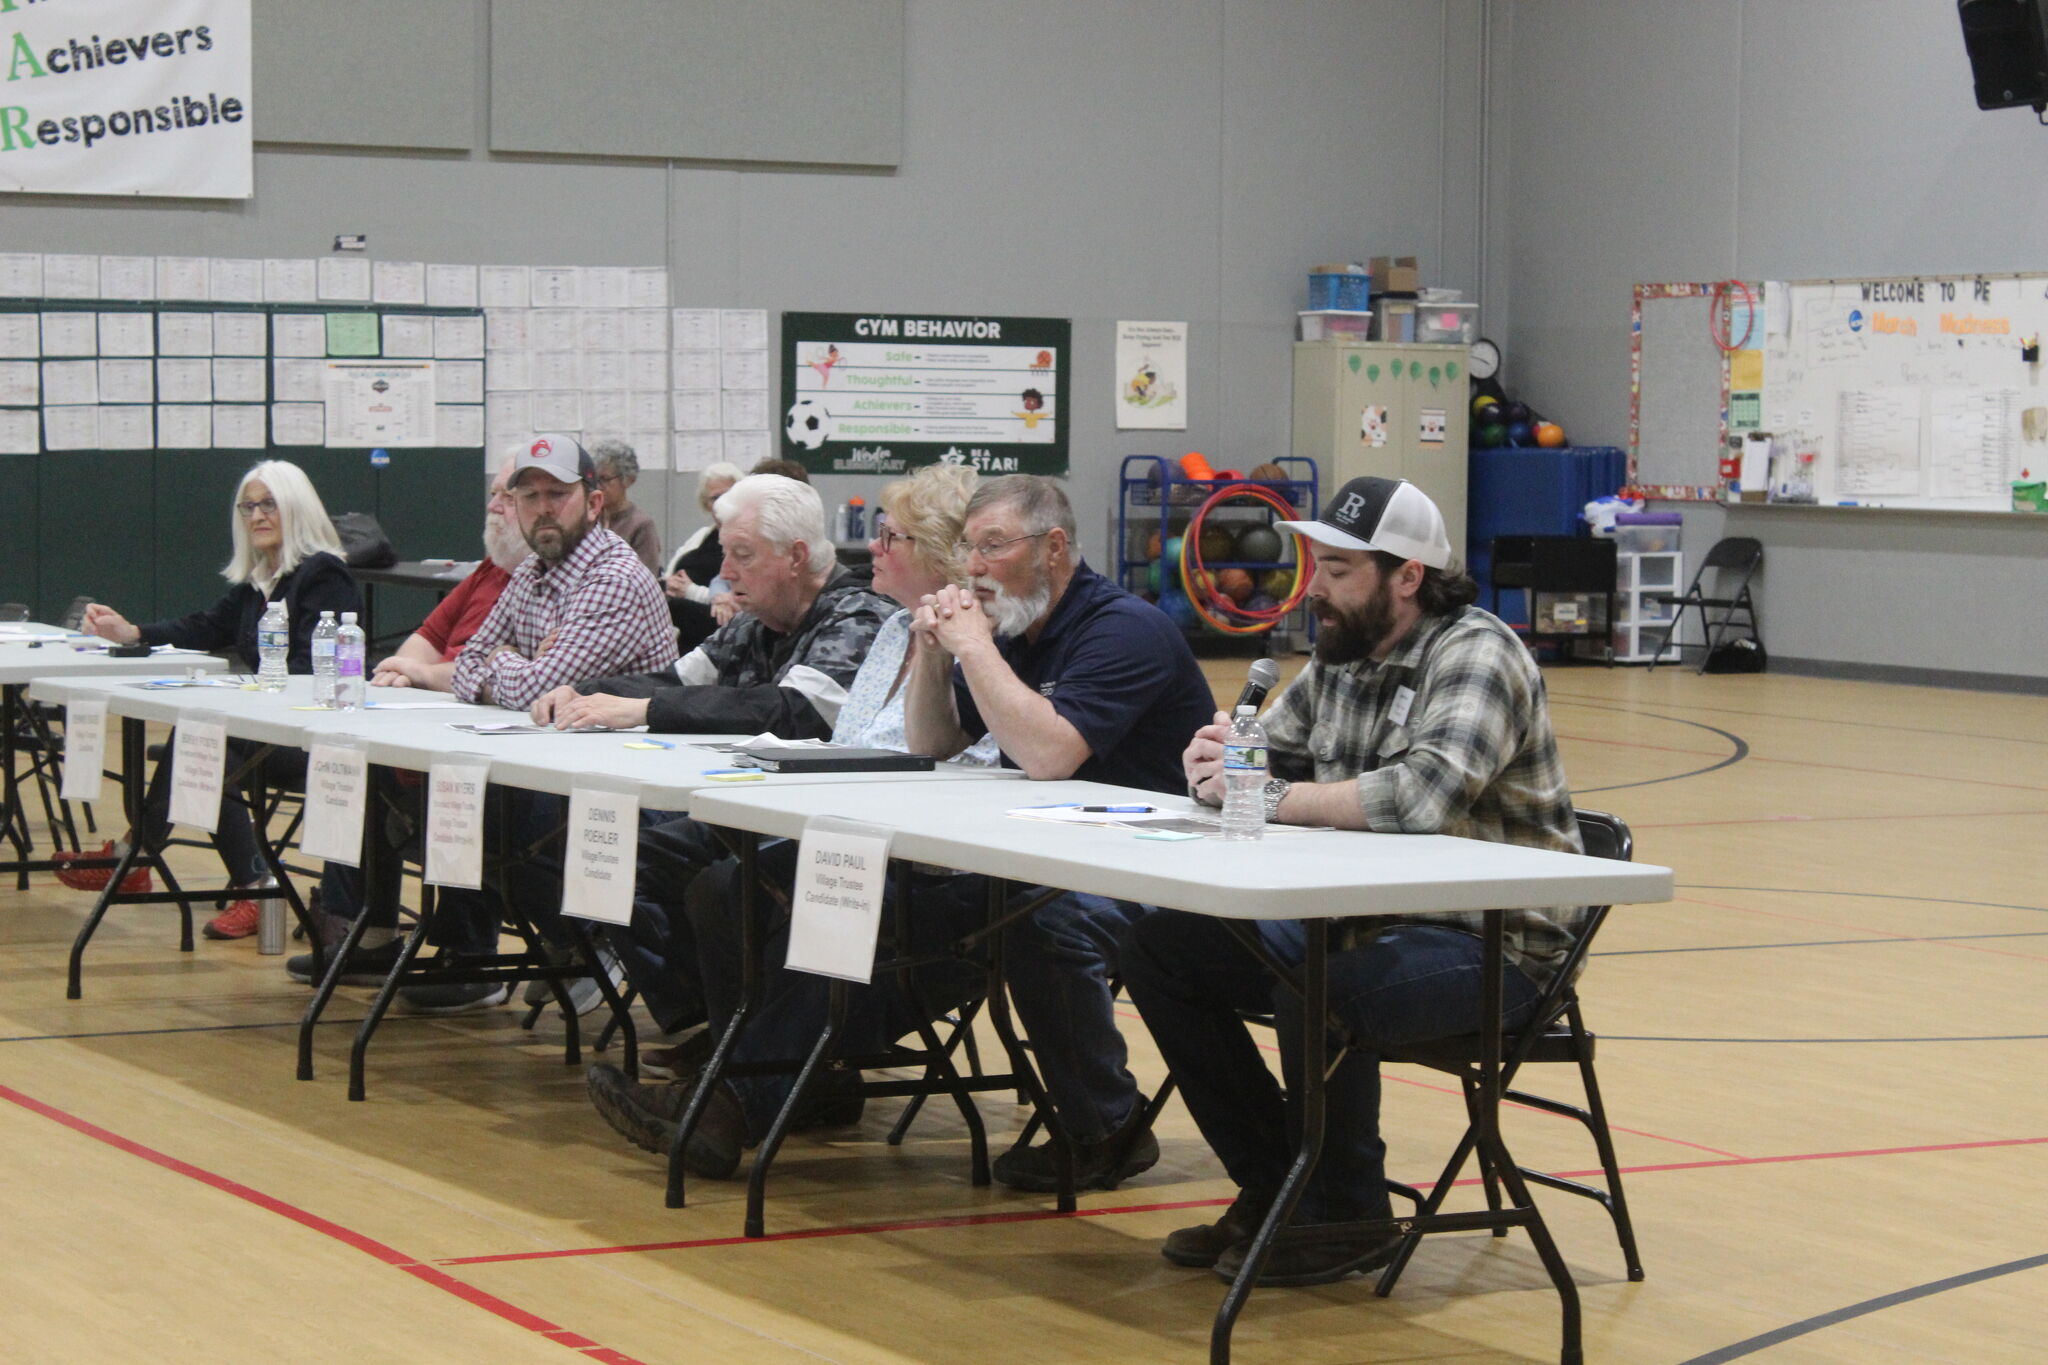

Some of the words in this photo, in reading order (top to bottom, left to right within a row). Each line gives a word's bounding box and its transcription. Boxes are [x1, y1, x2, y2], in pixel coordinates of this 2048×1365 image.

[7, 26, 212, 81] Achievers
[0, 93, 243, 151] Responsible
[1860, 282, 1925, 301] WELCOME
[1940, 282, 1955, 301] TO
[1974, 280, 1990, 301] PE
[855, 319, 899, 336] GYM
[904, 320, 1001, 339] BEHAVIOR
[1872, 312, 1917, 336] March
[1939, 312, 2010, 335] Madness
[885, 351, 912, 361] Safe
[847, 374, 912, 388] Thoughtful
[853, 400, 912, 410] Achievers
[838, 423, 912, 436] Responsible
[971, 457, 1018, 471] STAR!
[1338, 492, 1365, 518] R
[588, 807, 616, 823] DENNIS
[815, 850, 841, 867] DAVID
[843, 854, 866, 871] PAUL
[839, 876, 864, 891] Trustee
[805, 891, 839, 906] Candidate
